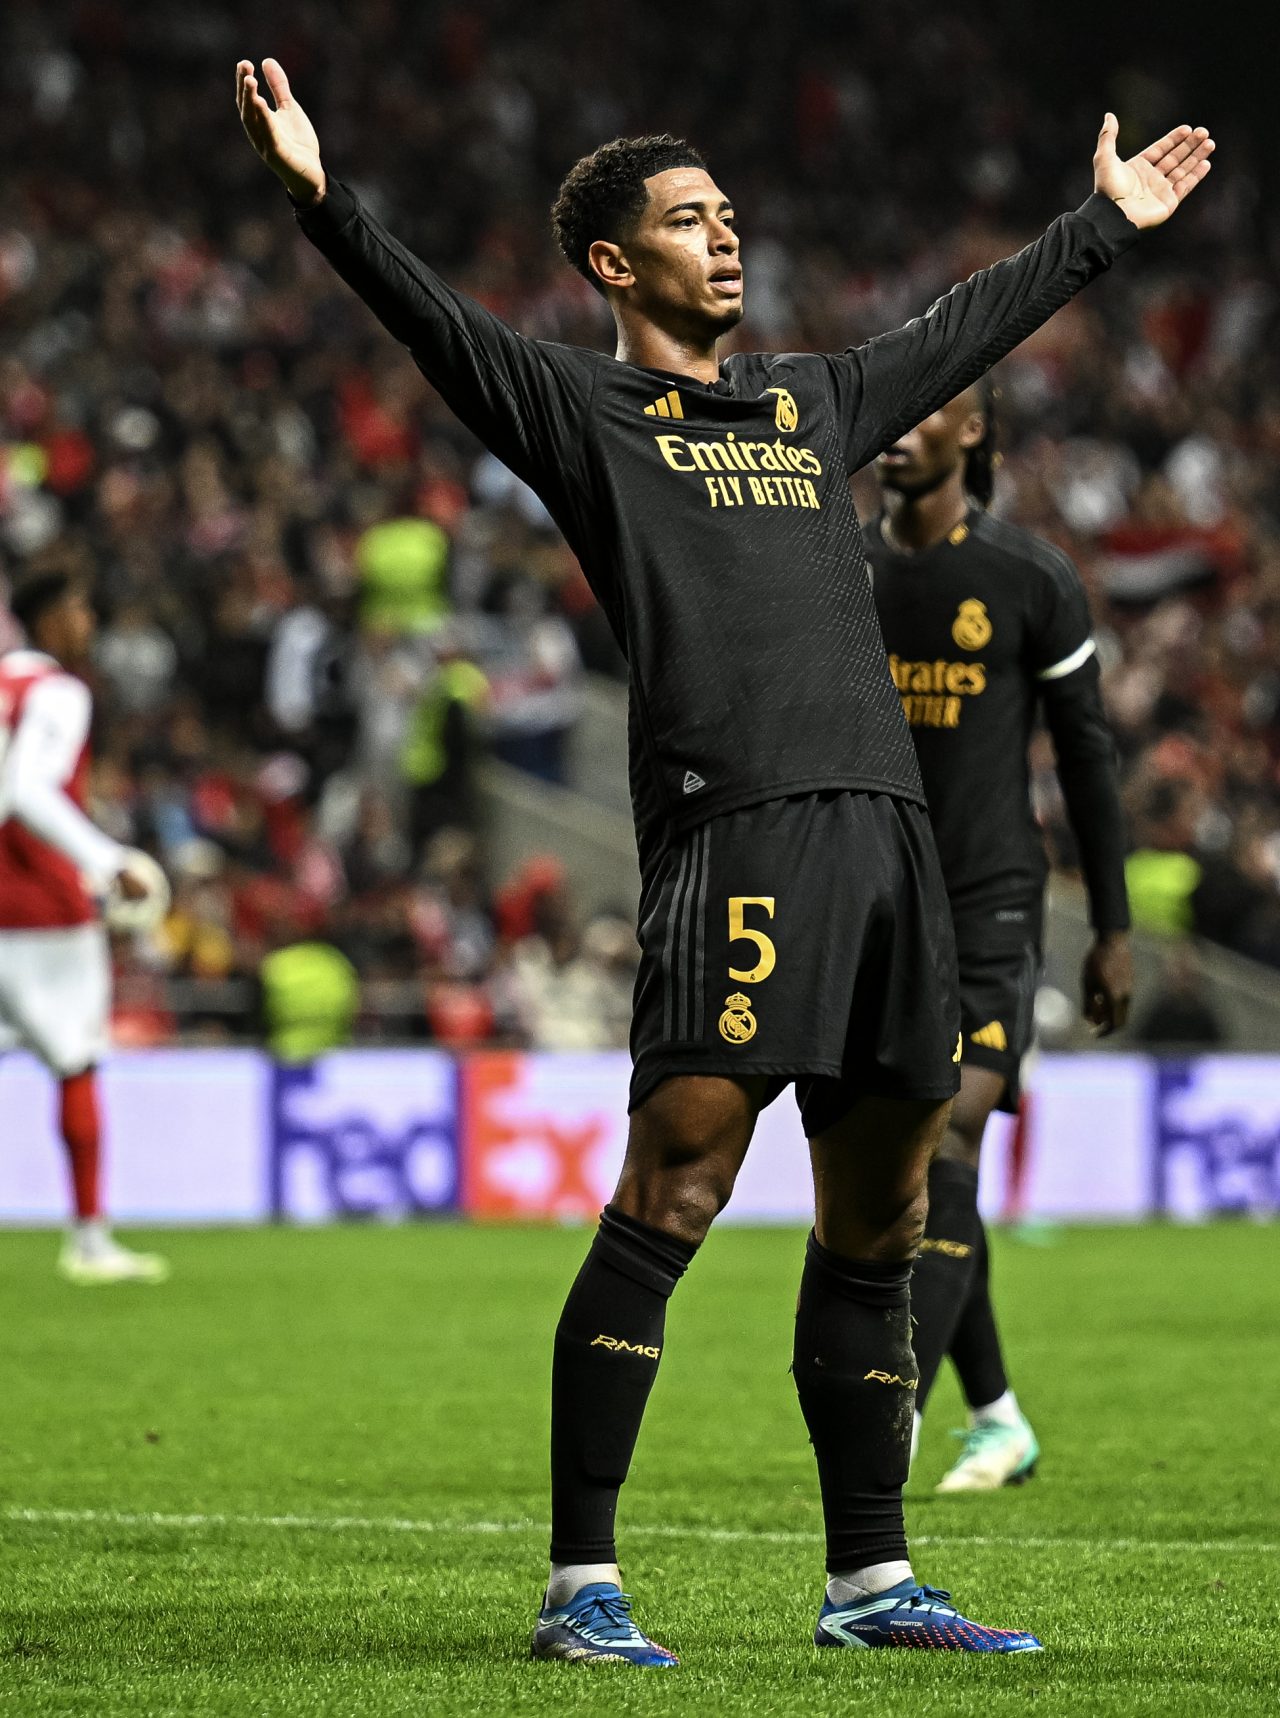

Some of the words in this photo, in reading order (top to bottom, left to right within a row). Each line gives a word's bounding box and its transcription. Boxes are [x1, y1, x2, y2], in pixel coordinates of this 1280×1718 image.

[654, 431, 822, 476] Emirates
[705, 477, 744, 508] FLY
[747, 477, 821, 510] BETTER
[728, 897, 776, 983] 5
[268, 1062, 605, 1222] FedEx
